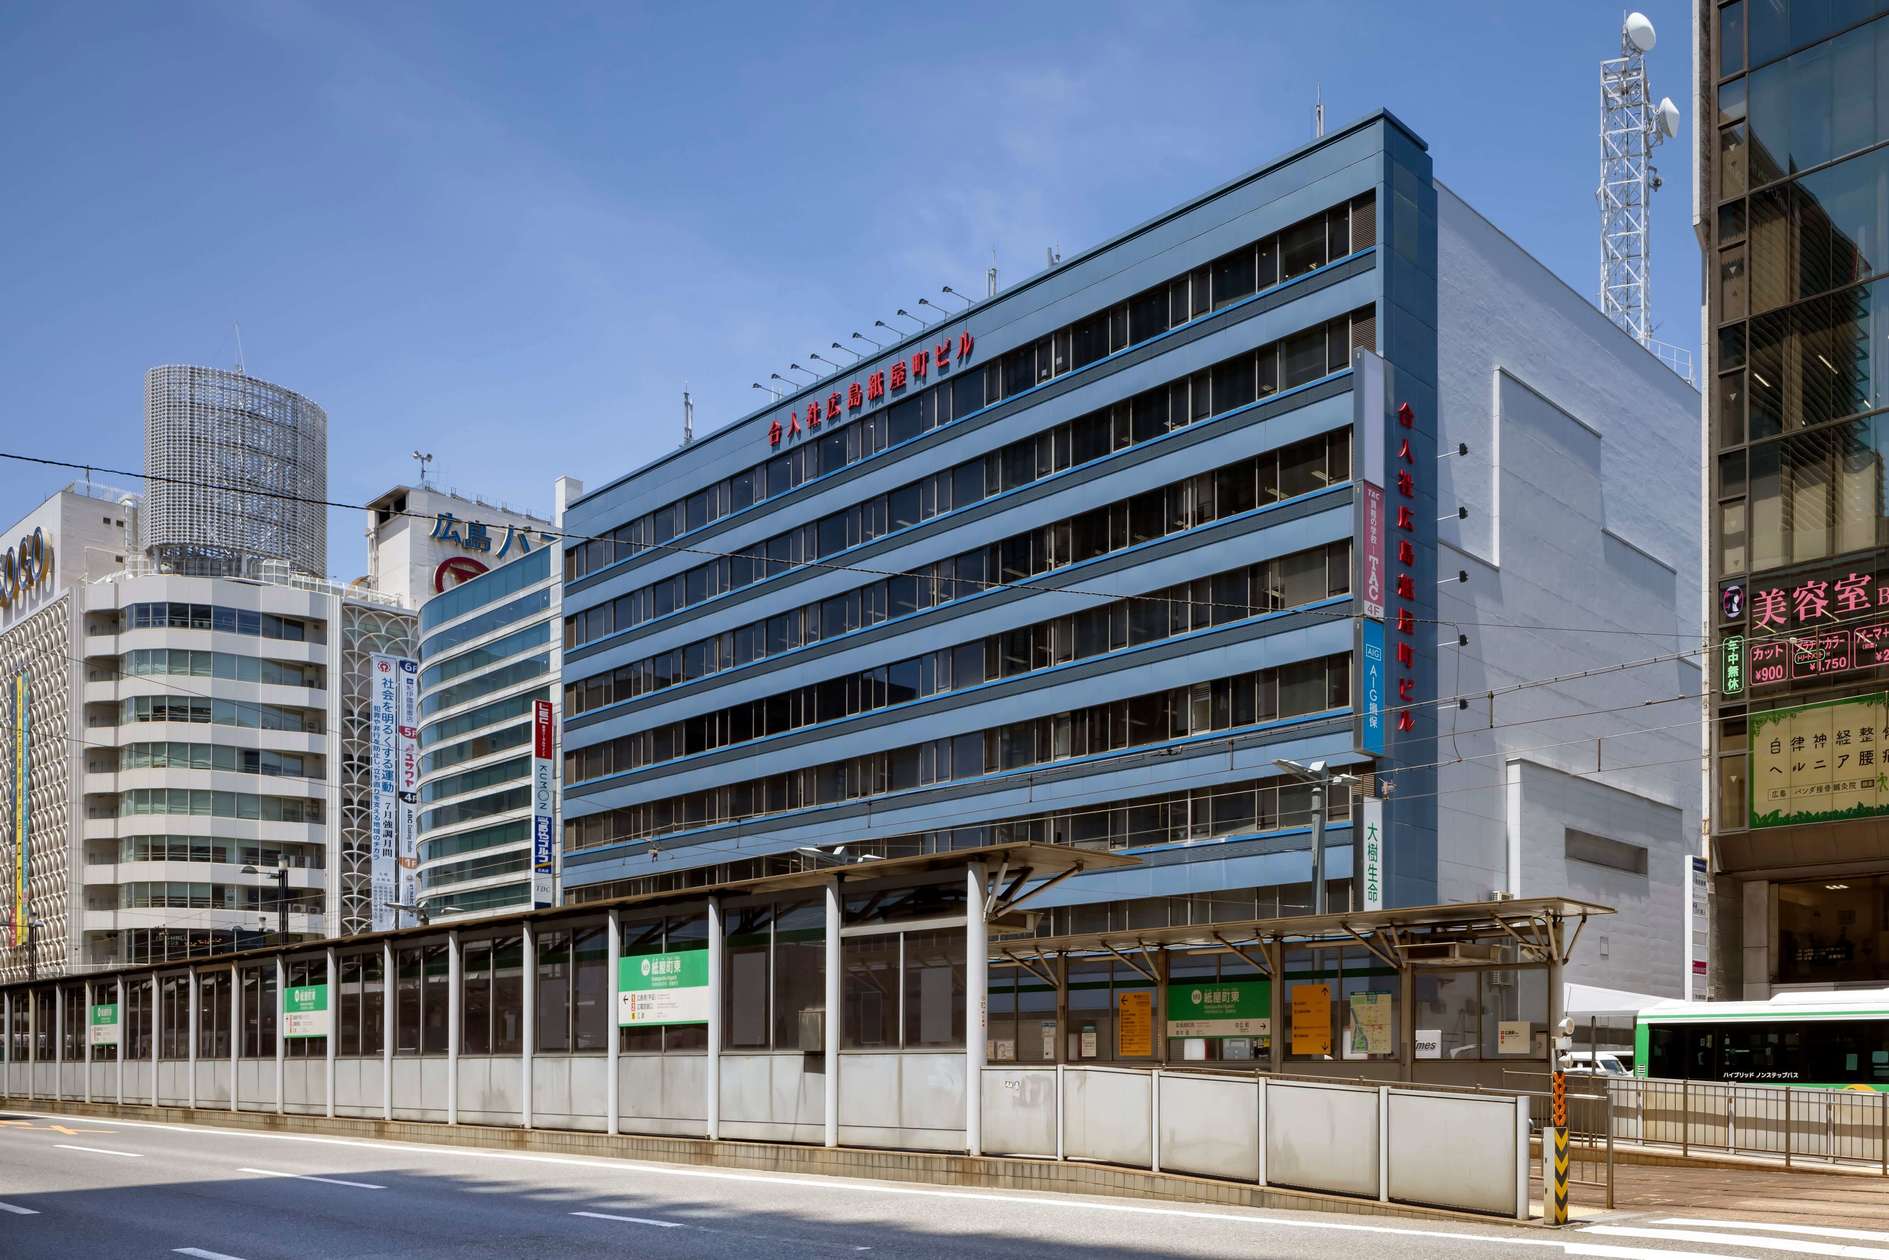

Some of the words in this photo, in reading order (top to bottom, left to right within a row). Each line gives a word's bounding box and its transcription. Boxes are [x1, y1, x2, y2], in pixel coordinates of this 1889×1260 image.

[768, 330, 975, 446] 合人社広島紙屋町ビル
[1368, 488, 1380, 500] TAC
[1368, 554, 1379, 601] TAC
[1367, 604, 1380, 617] 4F
[1751, 572, 1872, 631] 美容室
[1369, 649, 1379, 658] AIG
[1727, 640, 1739, 691] 年中無休
[1753, 644, 1783, 661] カット
[1755, 665, 1783, 681] ¥900
[382, 677, 394, 793] 社会を明るくする運動
[537, 764, 549, 810] KUMON
[382, 802, 393, 858] 7月強調月間
[1367, 822, 1378, 903] 大樹生命
